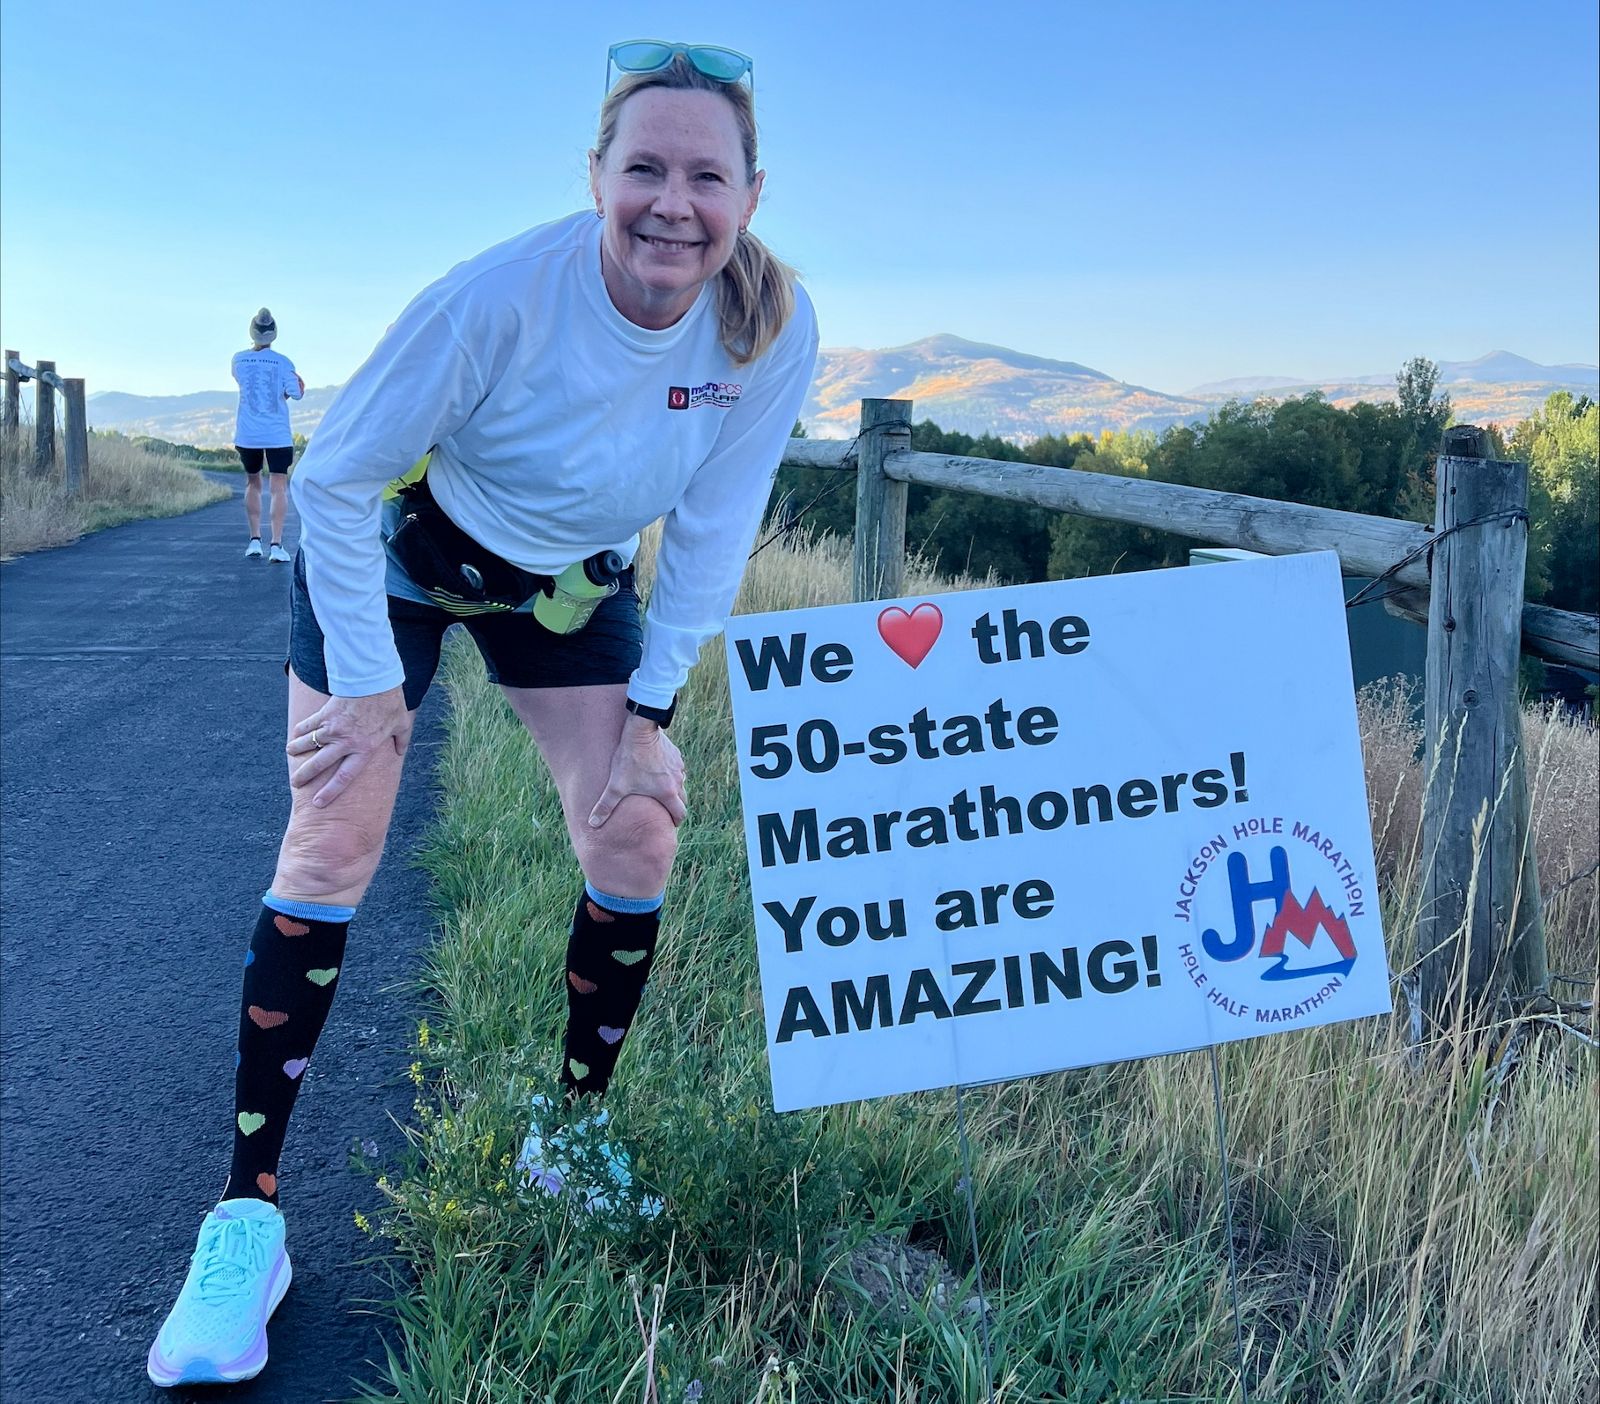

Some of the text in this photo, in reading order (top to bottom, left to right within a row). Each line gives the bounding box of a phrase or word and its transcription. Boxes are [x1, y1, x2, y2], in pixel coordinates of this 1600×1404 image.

[735, 608, 1091, 691] We the
[749, 698, 1059, 780] 50-state
[757, 751, 1249, 868] Marathoners!
[1174, 817, 1365, 922] JACKSON HOLE MARATHON
[762, 878, 1055, 953] You are
[775, 935, 1162, 1043] AMAZING!
[1178, 943, 1343, 1023] HOLE HALF MARATHON
